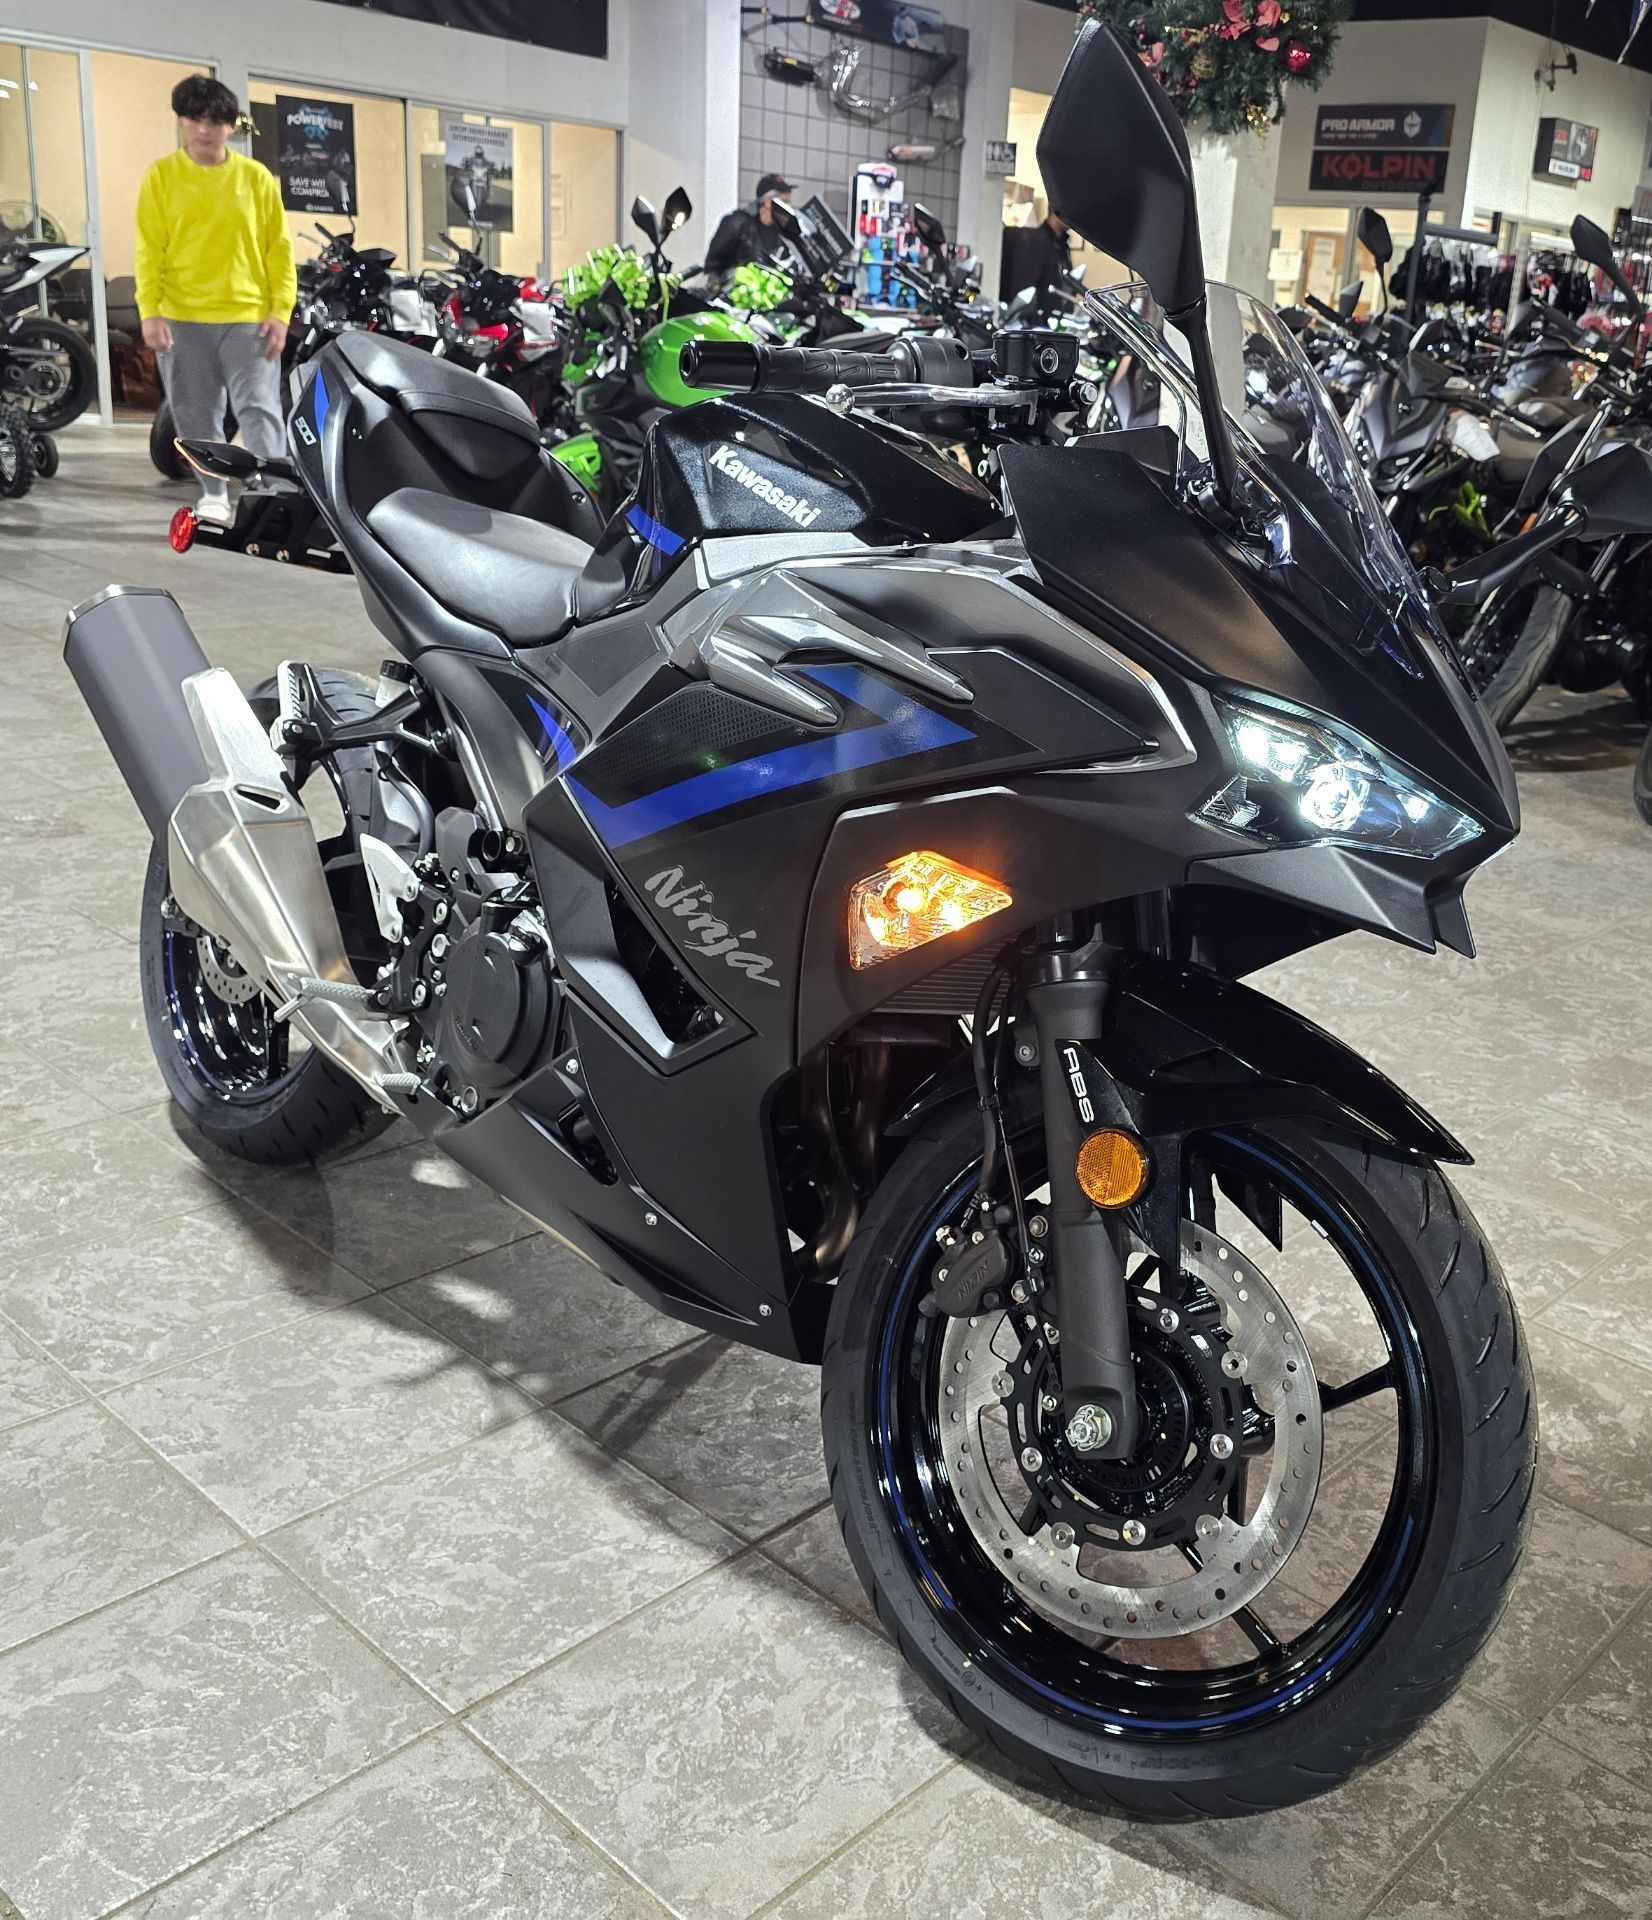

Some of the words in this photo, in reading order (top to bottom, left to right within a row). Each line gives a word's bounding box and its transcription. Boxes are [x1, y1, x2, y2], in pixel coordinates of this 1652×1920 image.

[1320, 151, 1437, 179] KOLPIN
[294, 415, 317, 445] 500
[708, 444, 821, 528] Kawasaki
[644, 864, 780, 987] Ninja
[1063, 1047, 1094, 1123] ABS
